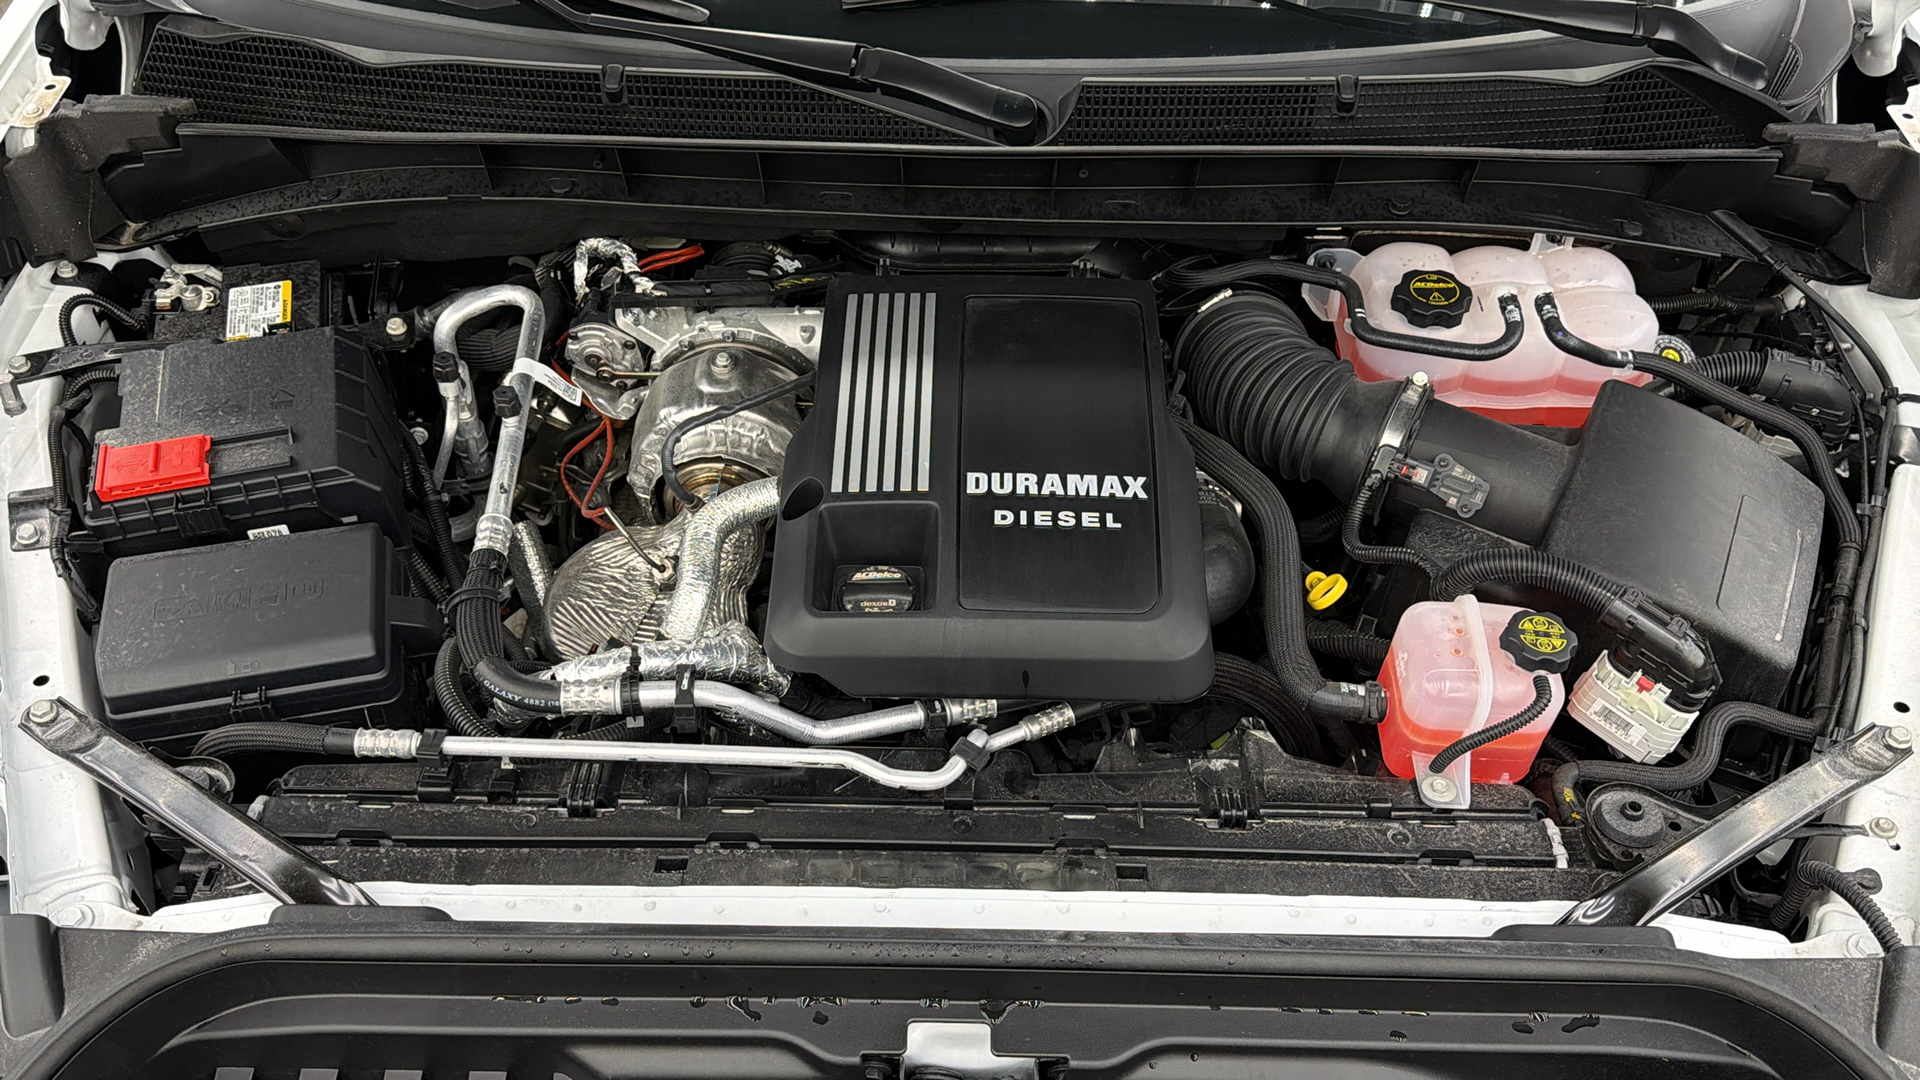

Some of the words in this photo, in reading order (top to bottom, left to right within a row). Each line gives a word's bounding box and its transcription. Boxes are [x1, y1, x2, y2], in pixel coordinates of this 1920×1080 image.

[1412, 281, 1455, 289] ACDelco
[966, 472, 1148, 499] DURAMAX
[993, 510, 1122, 528] DIESEL
[851, 571, 902, 581] ACDelco
[483, 679, 522, 702] GALAXY
[523, 697, 546, 707] 4882
